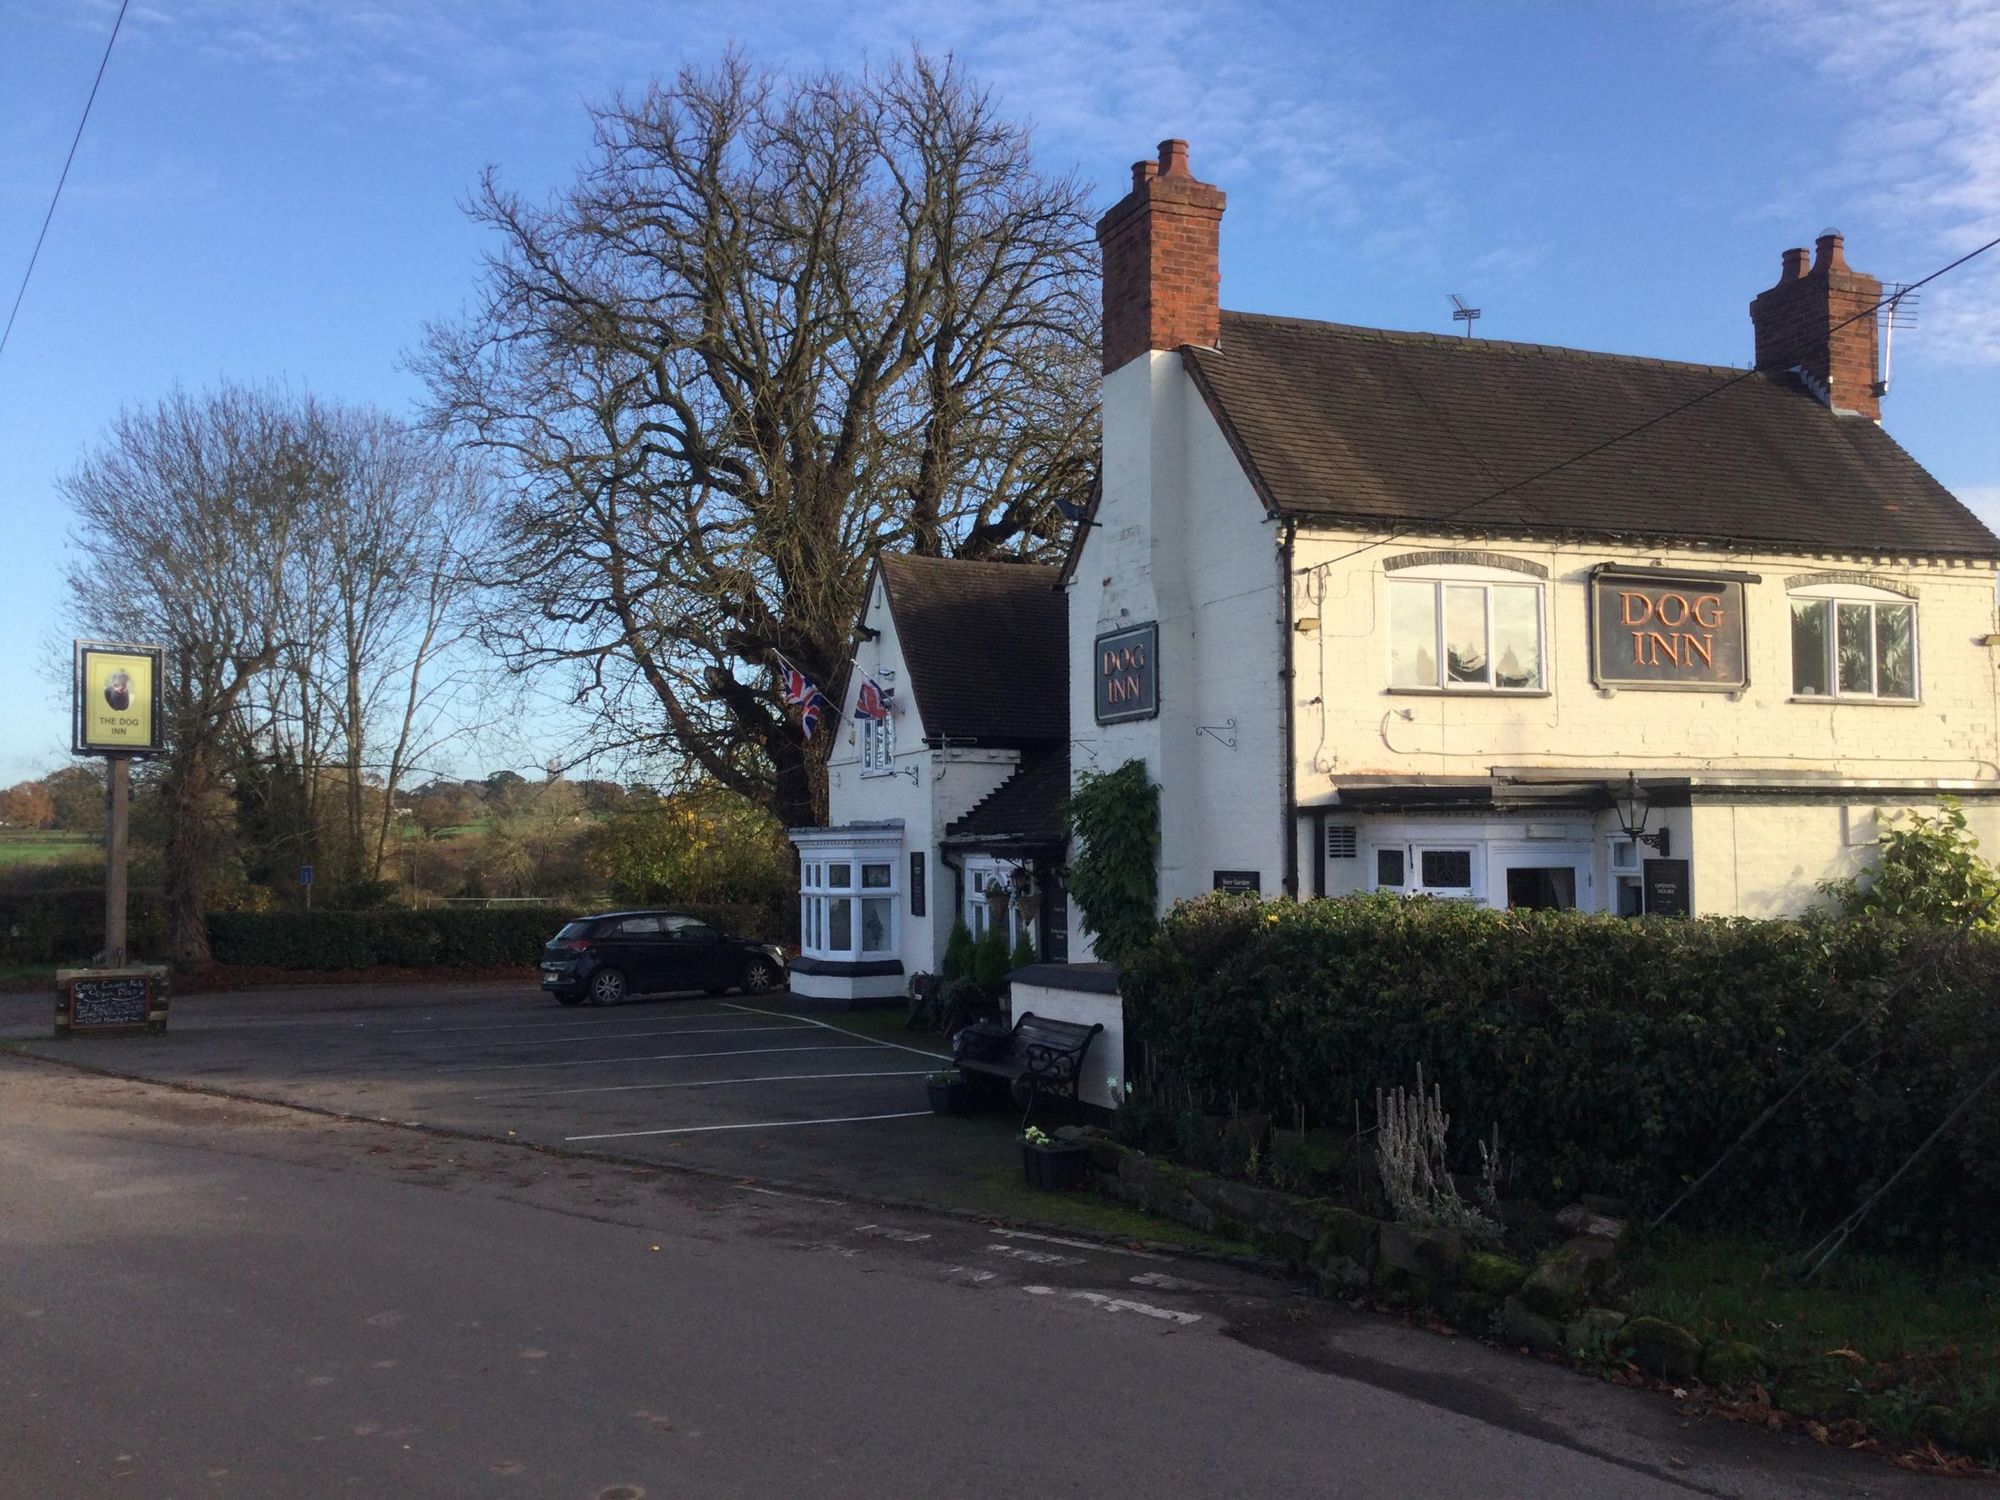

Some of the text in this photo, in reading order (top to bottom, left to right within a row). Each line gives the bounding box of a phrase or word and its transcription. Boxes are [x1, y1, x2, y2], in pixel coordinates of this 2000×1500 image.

[1619, 592, 1724, 628] DOG
[1104, 643, 1144, 675] DOG
[1631, 631, 1713, 668] INN
[1108, 676, 1140, 704] INN
[99, 716, 139, 726] THE DOG
